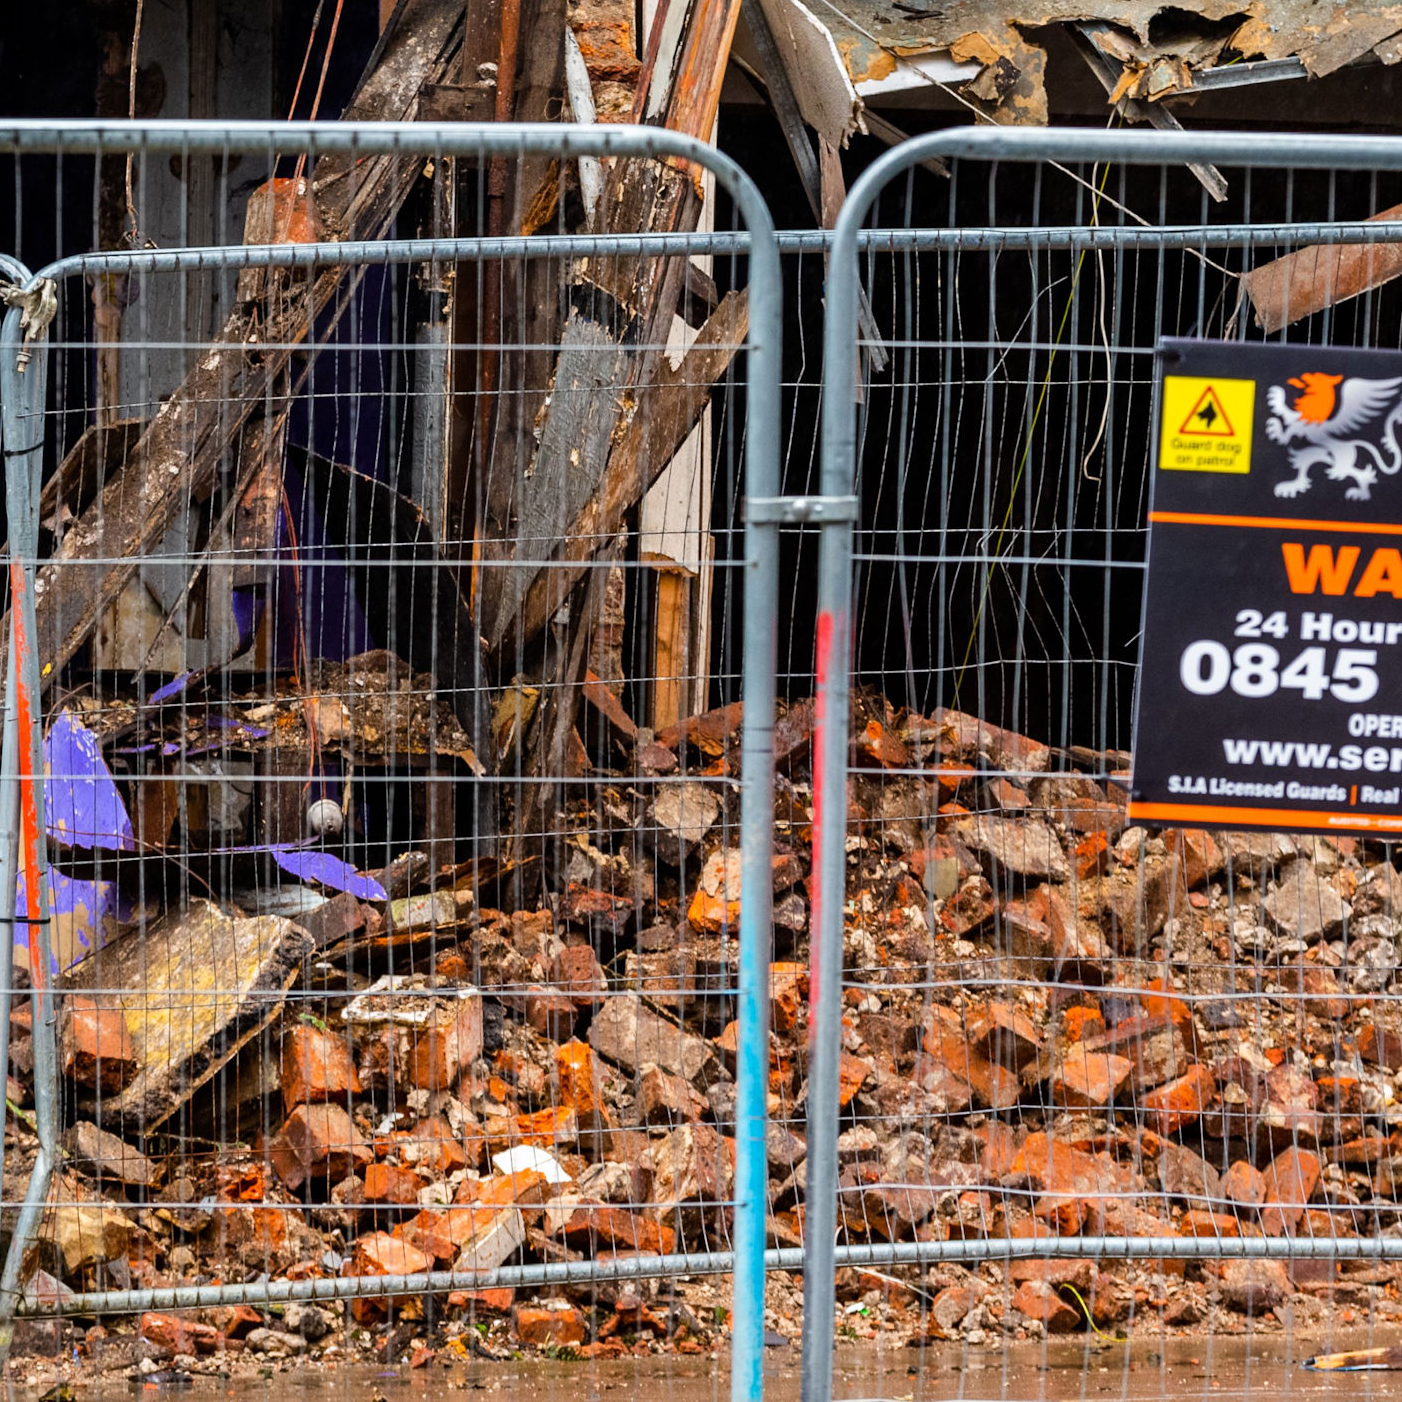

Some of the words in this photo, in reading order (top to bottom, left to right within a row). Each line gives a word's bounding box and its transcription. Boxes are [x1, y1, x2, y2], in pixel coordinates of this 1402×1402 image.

[1234, 609, 1289, 638] 24
[1180, 640, 1379, 703] 0845
[1209, 777, 1284, 799] Licensed
[1286, 781, 1347, 802] Guards
[1361, 785, 1402, 804] Real
